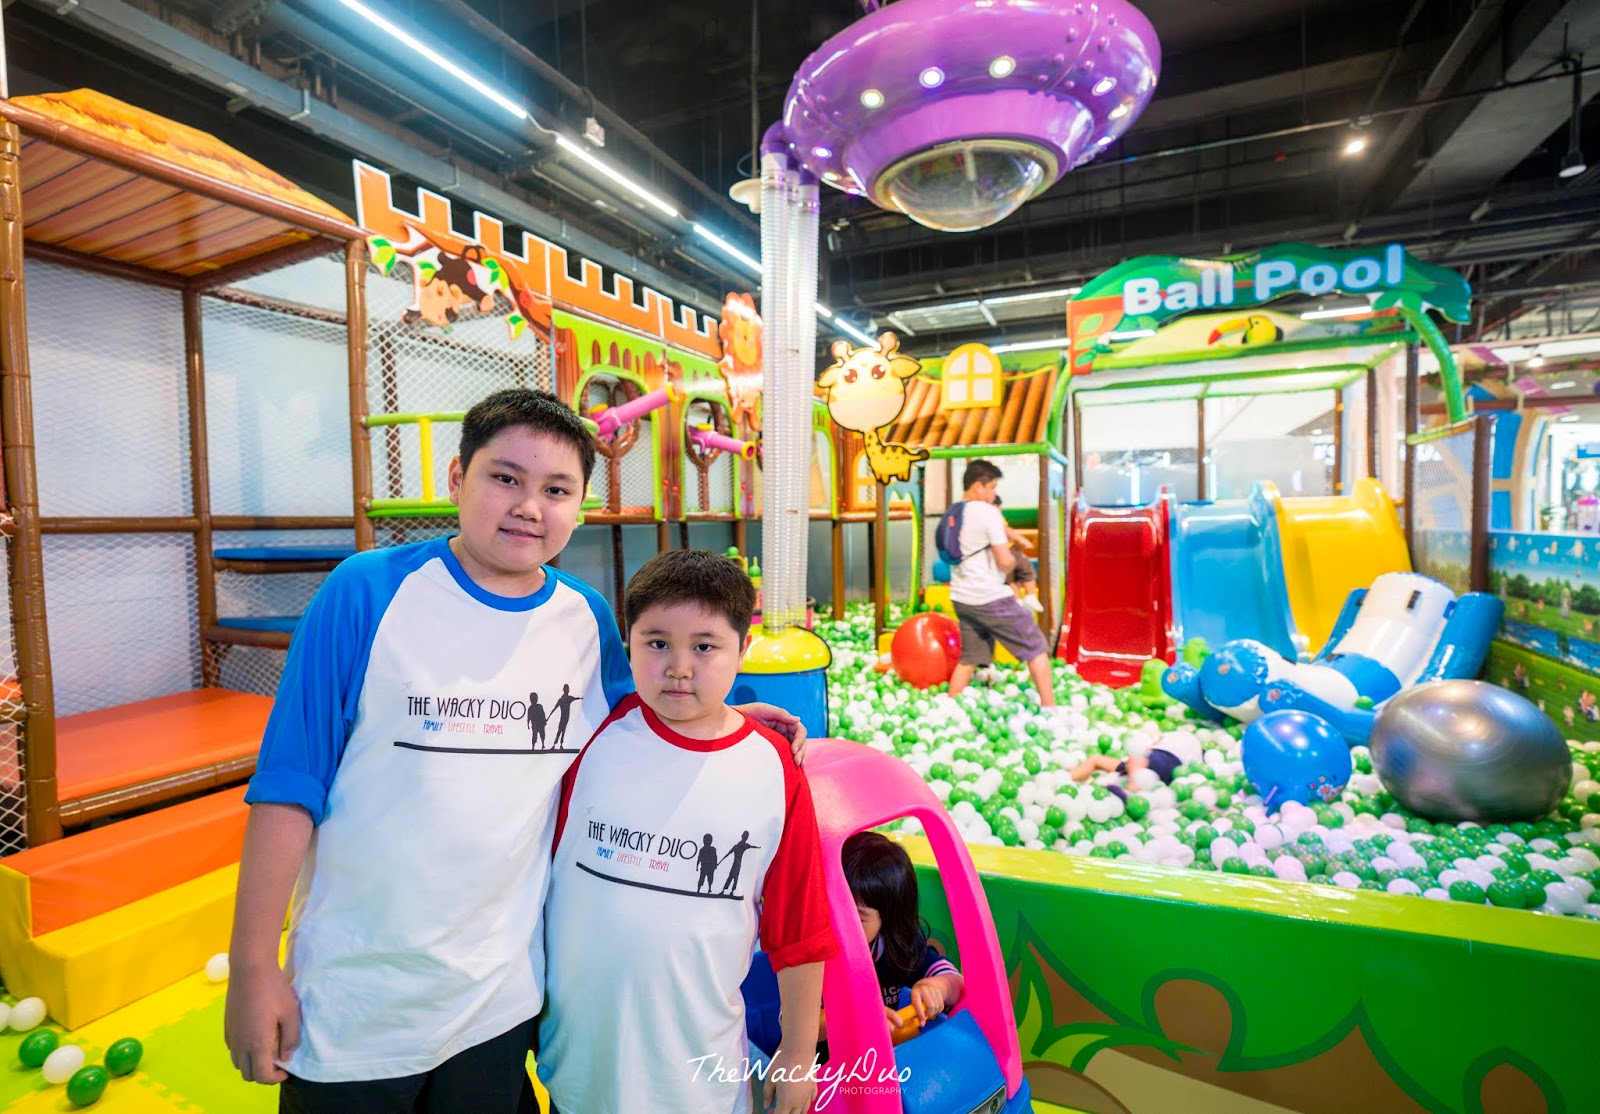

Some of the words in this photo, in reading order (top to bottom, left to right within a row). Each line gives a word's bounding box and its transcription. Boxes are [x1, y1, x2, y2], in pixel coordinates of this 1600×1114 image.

[1122, 266, 1235, 316] Ball
[1253, 242, 1405, 301] Pool
[407, 696, 431, 716] THE
[437, 696, 485, 719] WACKY
[489, 699, 527, 721] DUO
[422, 719, 445, 732] FAMILY
[447, 722, 476, 734] LIFESTYLE
[483, 723, 504, 735] TRAVEL
[588, 820, 606, 842] THE
[609, 825, 656, 853] WACKY
[657, 836, 698, 860] DUO
[596, 846, 615, 860] FAMILY
[616, 852, 643, 867] LIFESTYLE
[648, 858, 670, 872] TRAVEL
